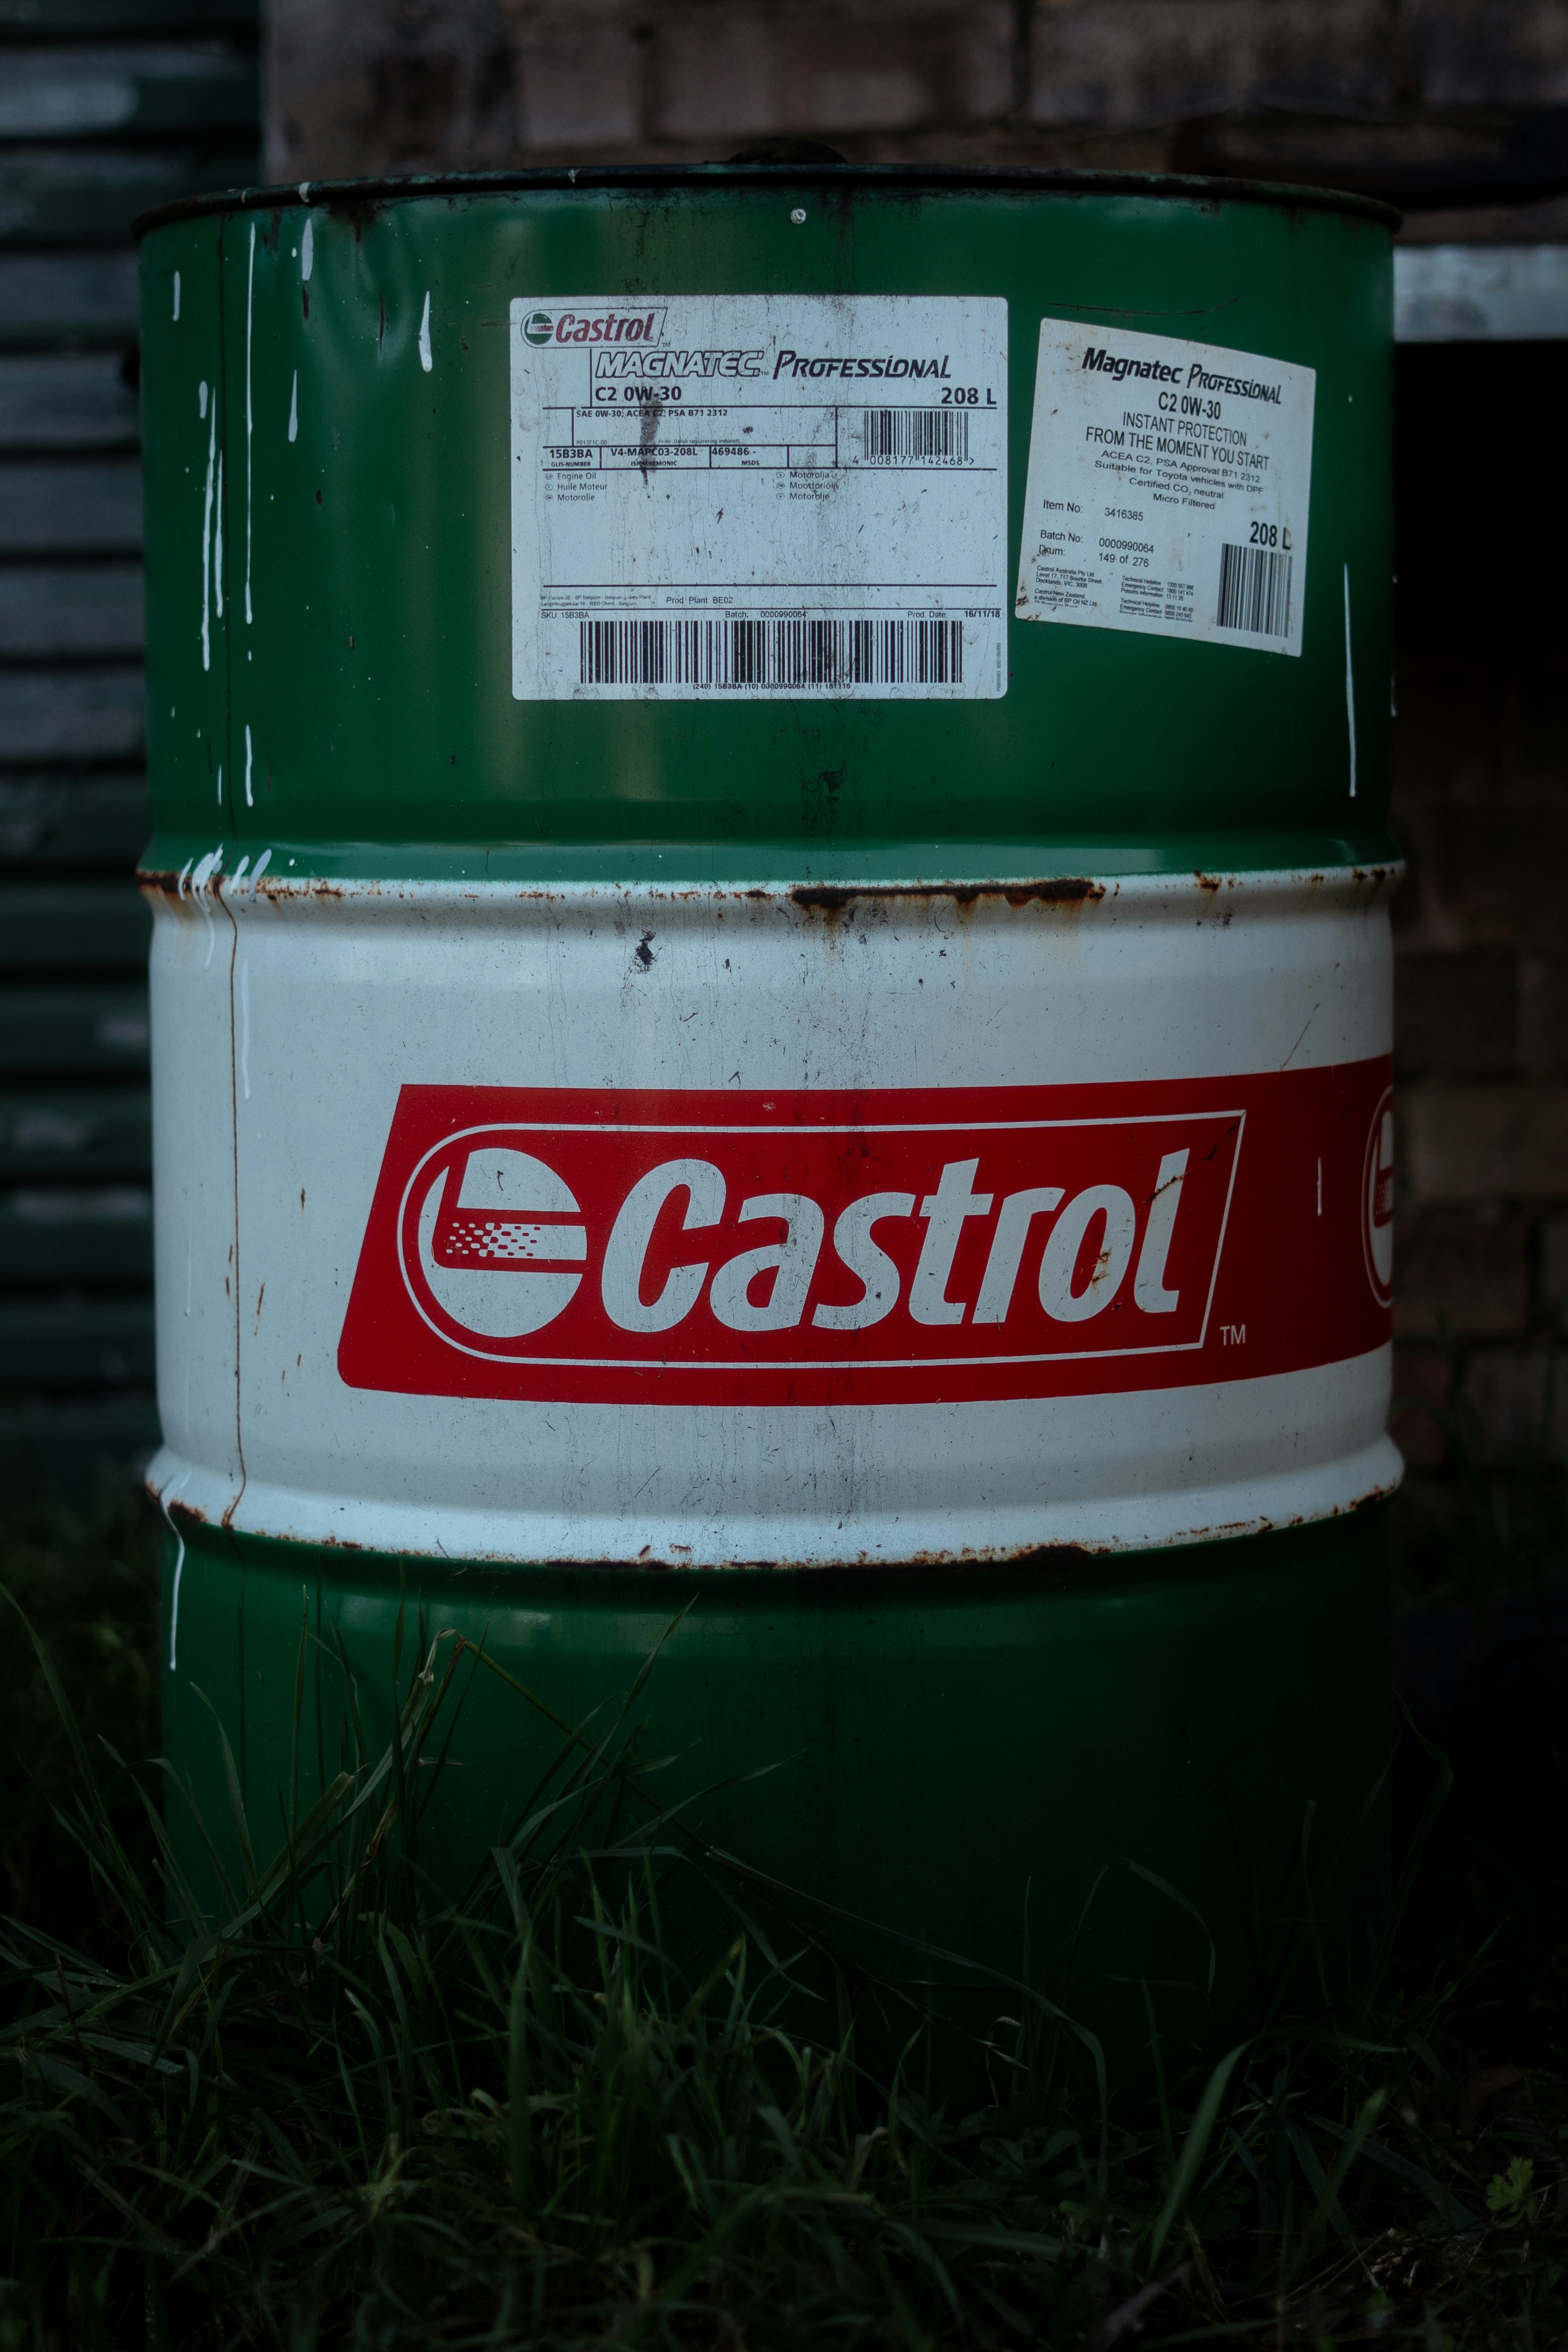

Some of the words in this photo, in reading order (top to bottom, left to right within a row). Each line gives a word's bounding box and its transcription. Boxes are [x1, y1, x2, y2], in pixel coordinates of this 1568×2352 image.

[556, 313, 655, 343] Castrol
[595, 350, 764, 378] MAGNATEC
[772, 350, 951, 380] PROFESSIONAL
[1082, 347, 1183, 384] Magnatec
[1187, 363, 1281, 405] PROFESSIONAL
[595, 387, 617, 401] C2
[624, 386, 682, 401] 0W-30
[940, 387, 979, 405] 208
[987, 388, 996, 405] L
[595, 410, 625, 419] 0W-30;
[668, 409, 685, 417] PSA
[1158, 391, 1177, 413] C2
[1180, 395, 1221, 420] 0W-30
[1123, 411, 1175, 434] INSTANT
[1178, 420, 1247, 446] PROTECTION
[550, 449, 593, 458] 15B3BA
[611, 447, 698, 456] V4-MAPC03-208L
[712, 447, 749, 456] 469486
[1086, 427, 1125, 446] FROM
[1129, 433, 1153, 450] THE
[1157, 438, 1209, 460] MOMENT
[1211, 446, 1234, 464] YOU
[1237, 451, 1269, 471] START
[870, 456, 914, 465] 008177
[921, 457, 963, 466] 142468
[1101, 450, 1133, 461] ACEA
[1136, 455, 1152, 465] C2,
[1156, 458, 1177, 468] PSA
[1180, 462, 1219, 475] Approval
[1222, 467, 1237, 478] B71
[1240, 473, 1260, 483] 2312
[557, 473, 583, 481] Engine
[790, 472, 830, 480] Motorolja
[1095, 461, 1136, 473] Suitable
[1139, 467, 1153, 475] for
[1157, 469, 1188, 482] Toyota
[1190, 475, 1225, 488] vehicles
[1228, 481, 1244, 491] with
[1246, 484, 1264, 494] DPF
[790, 493, 830, 501] Motorolje
[1129, 478, 1170, 490] Certified
[1194, 488, 1224, 500] neutral
[1043, 500, 1064, 511] Item
[1067, 502, 1083, 513] No:
[1105, 507, 1144, 521] 3416385
[1153, 493, 1179, 504] Micro
[1182, 498, 1216, 510] Filtered
[1040, 530, 1066, 542] Batch
[1068, 533, 1083, 544] No:
[1099, 537, 1154, 554] 0000990064
[1250, 521, 1278, 546] 208
[1283, 527, 1291, 550] L
[1039, 545, 1066, 556] Drum:
[1099, 552, 1115, 564] 149
[1119, 555, 1129, 564] of
[1133, 557, 1149, 568] 276
[1121, 582, 1146, 591] Emergency
[965, 610, 1000, 618] 16/11/18
[1120, 604, 1144, 613] Emergency
[600, 1147, 1190, 1333] Castrol
[1220, 1324, 1246, 1346] TM
